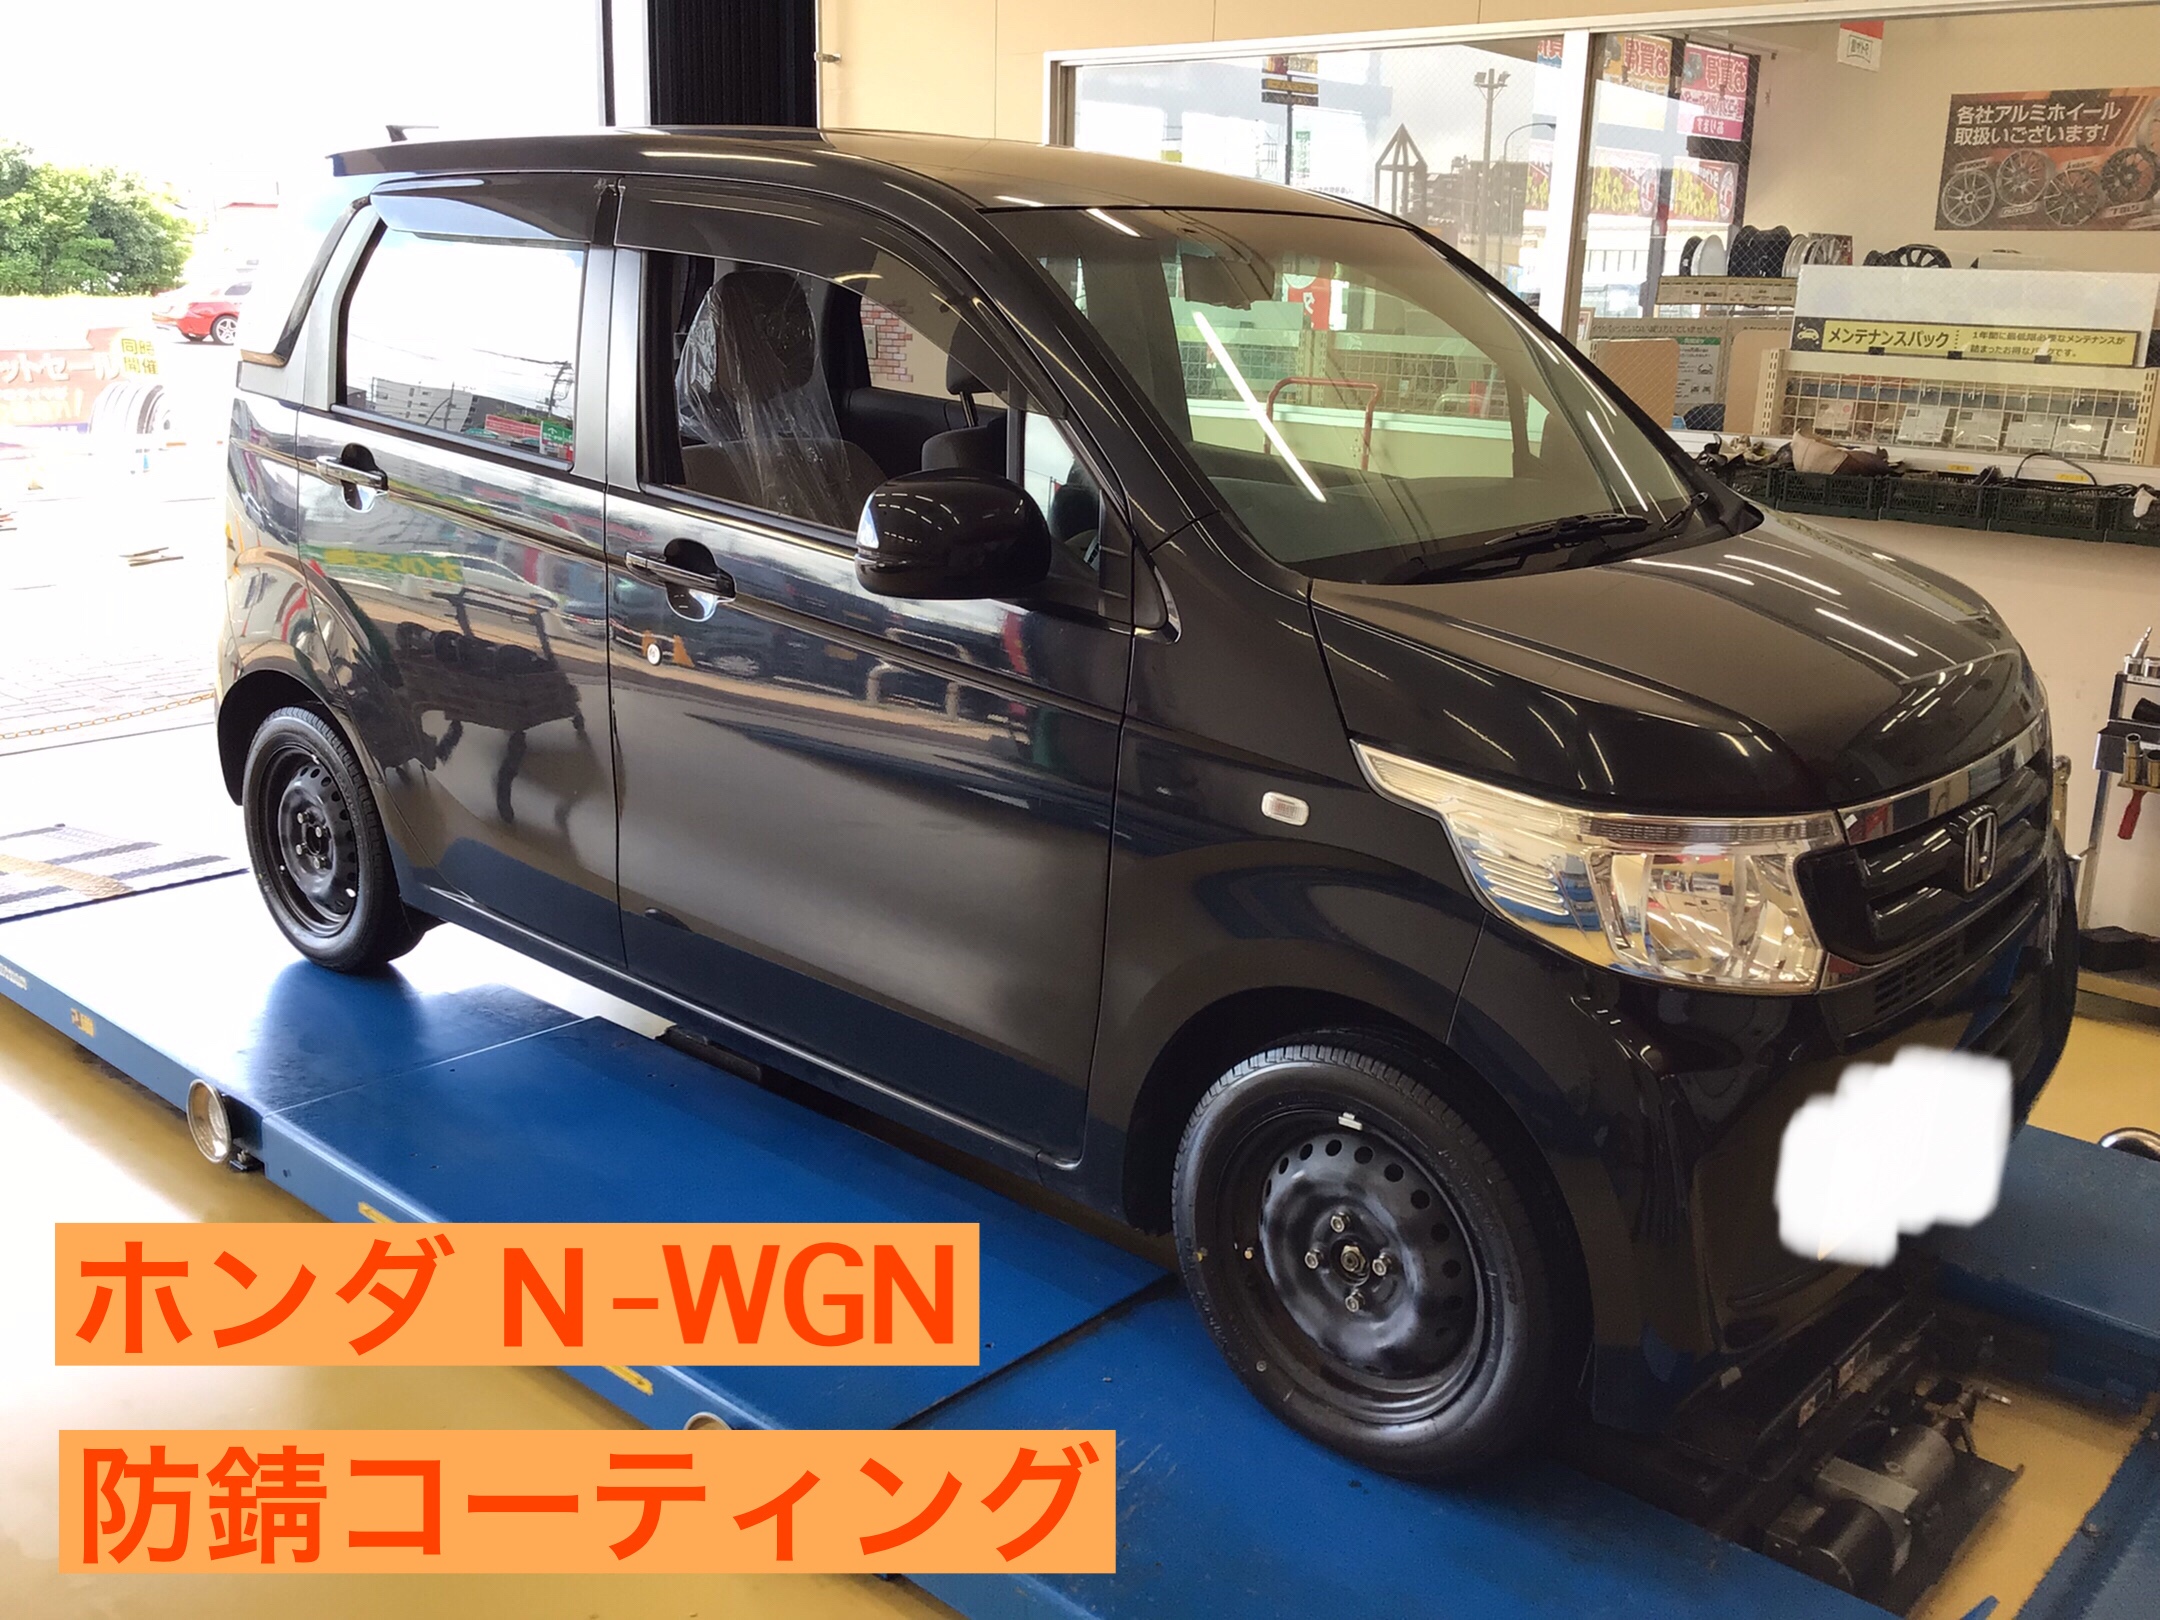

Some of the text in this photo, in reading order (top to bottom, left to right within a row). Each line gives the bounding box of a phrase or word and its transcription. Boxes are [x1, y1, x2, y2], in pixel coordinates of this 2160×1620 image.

[1957, 101, 2121, 125] 各社アルミホイール
[1828, 327, 1951, 349] メンテナンスパック
[1970, 343, 2077, 358] 詰まったお得なパクです。
